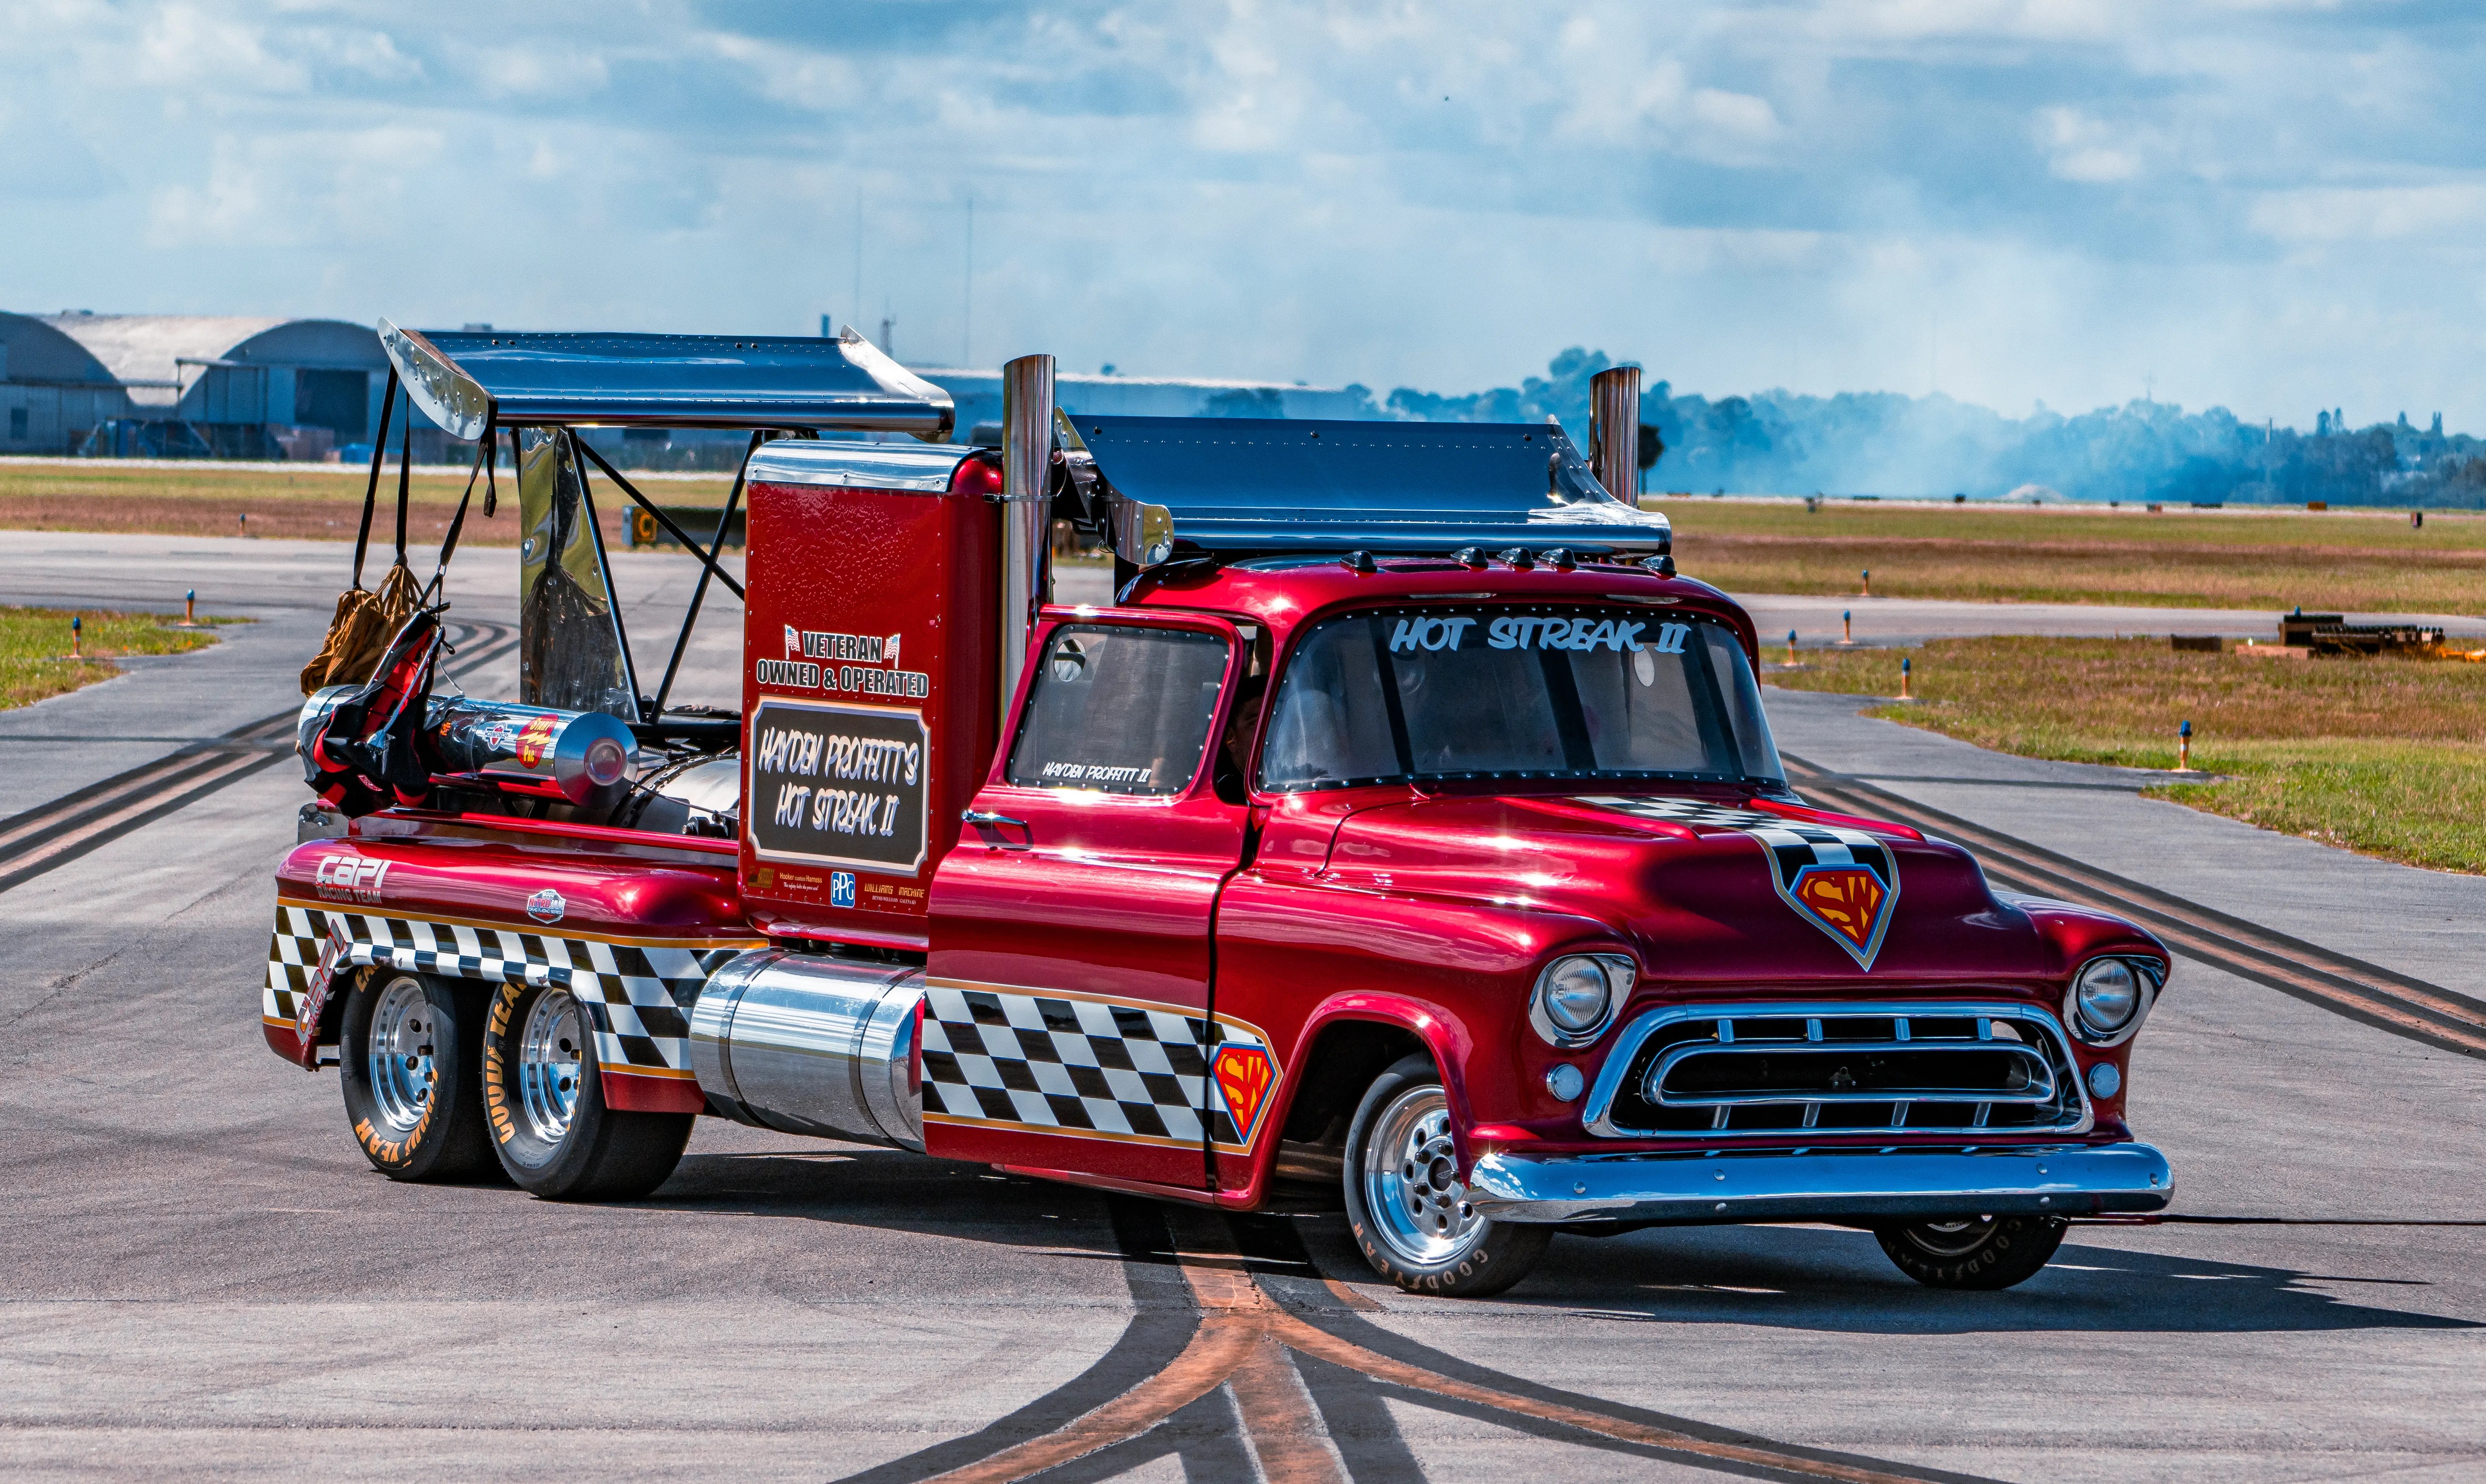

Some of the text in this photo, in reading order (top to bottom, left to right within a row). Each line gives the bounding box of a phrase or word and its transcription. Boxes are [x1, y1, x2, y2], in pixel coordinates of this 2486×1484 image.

[802, 631, 883, 663] VETERAN
[1389, 616, 1691, 654] HOT STREAK II
[756, 659, 929, 699] OWNED & OPERATED
[758, 727, 919, 786] HAYDEN PROFFITT'S
[1043, 762, 1152, 783] HAYDEN PROFFITT II
[775, 782, 900, 837] HOT STREAK II
[780, 872, 794, 881] Hooker
[806, 875, 822, 884] Harness
[832, 873, 854, 901] PPG
[864, 883, 925, 898] WILLIAMS MACHINE
[316, 885, 382, 904] RACING TEAM
[355, 966, 381, 993] EA
[1354, 1222, 1488, 1289] GOODYEAR
